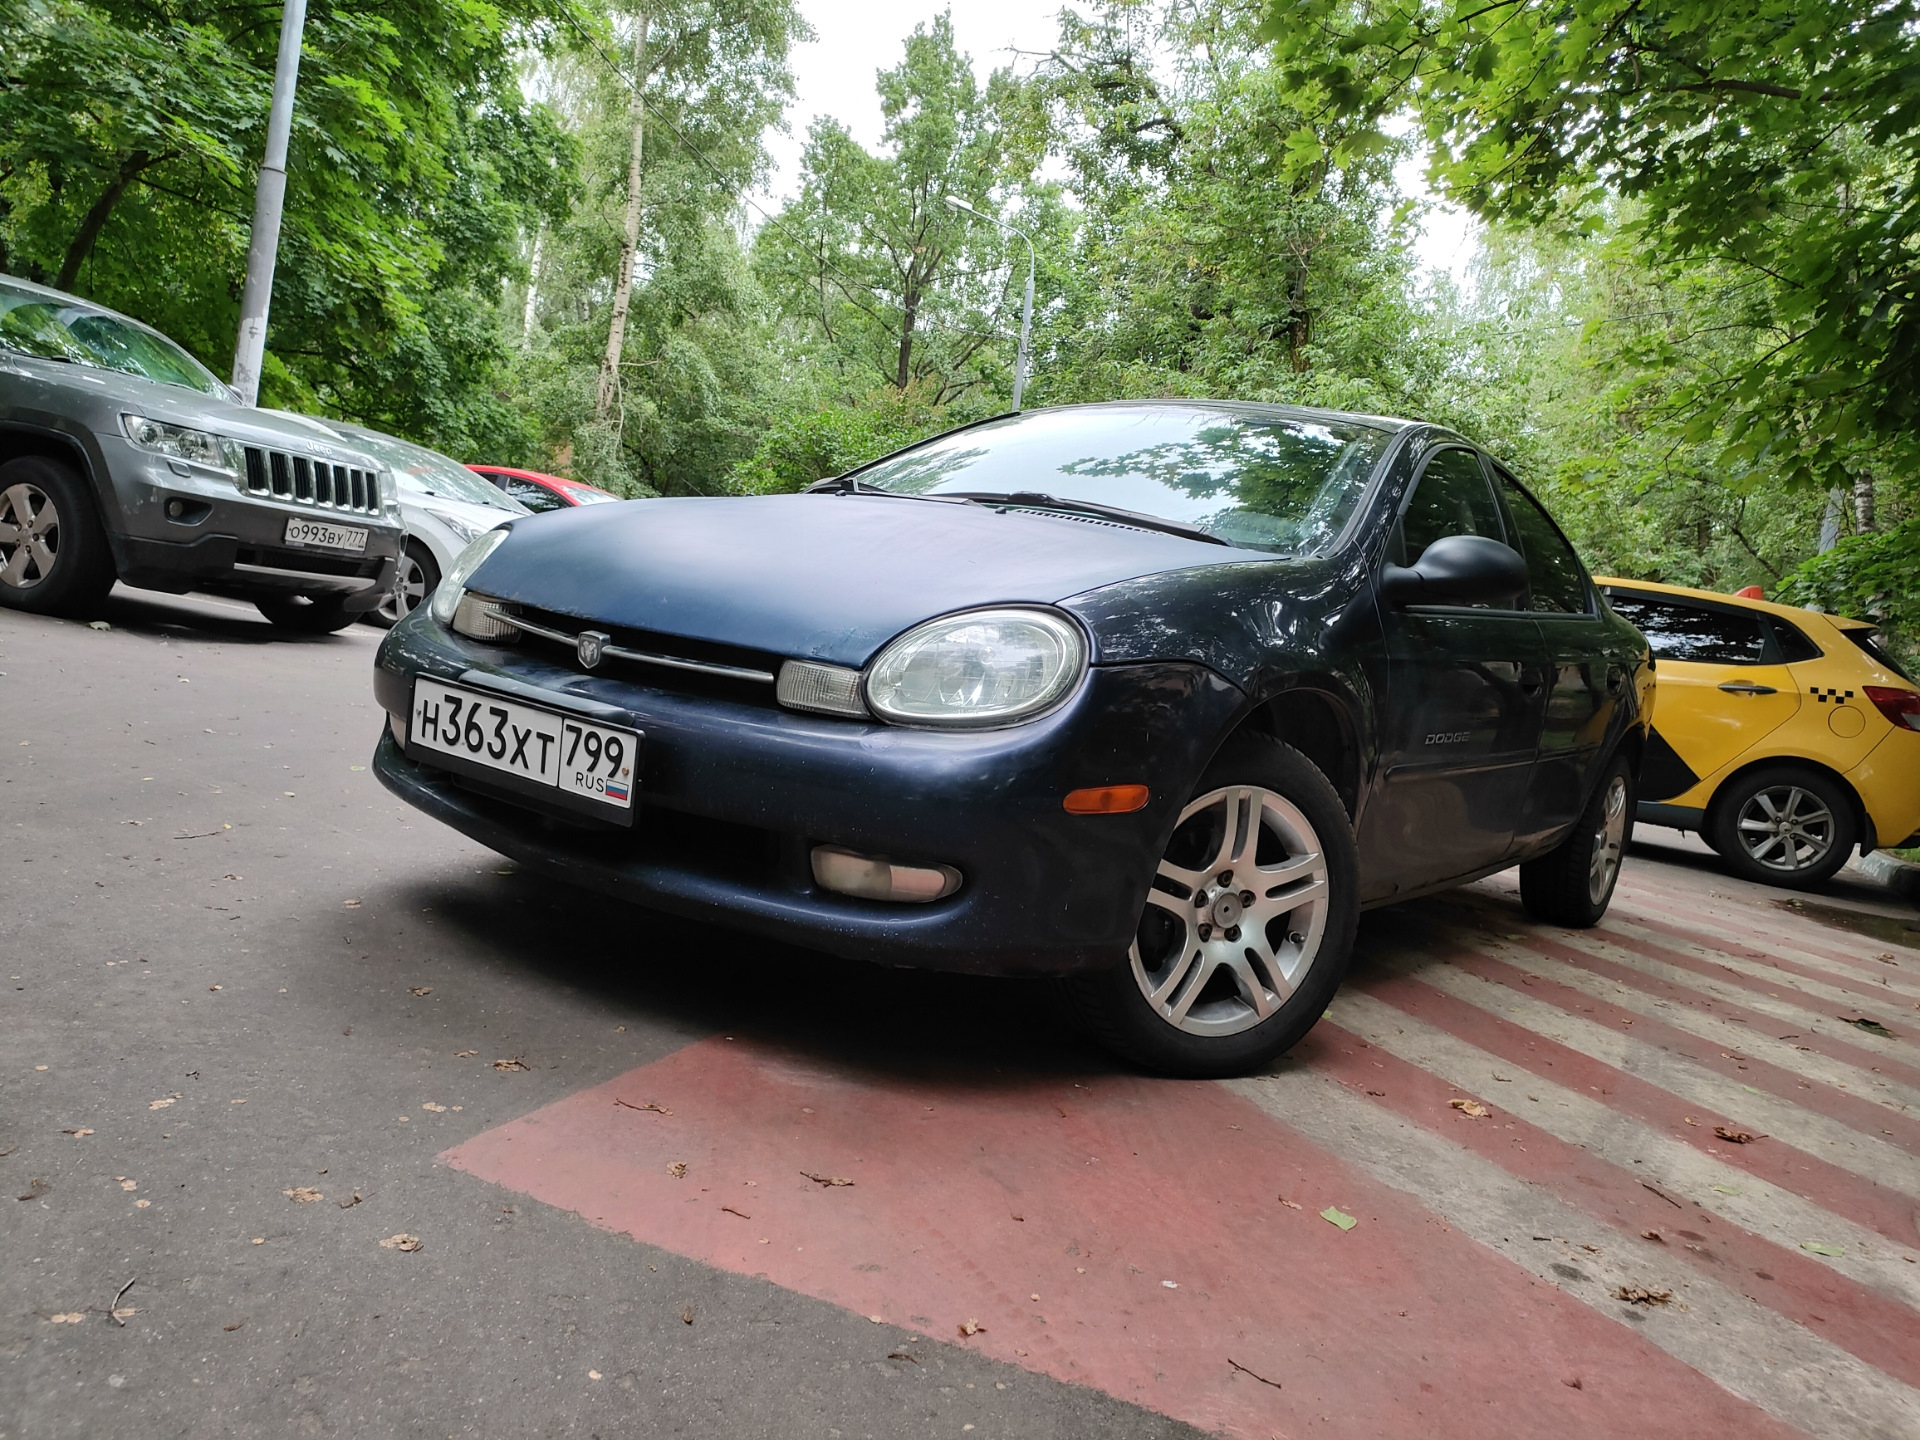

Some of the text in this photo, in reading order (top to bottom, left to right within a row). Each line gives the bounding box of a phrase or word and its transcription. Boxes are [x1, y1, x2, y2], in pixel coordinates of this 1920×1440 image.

[1425, 731, 1470, 744] DODGE
[565, 724, 624, 778] 799
[575, 771, 604, 793] RUS
